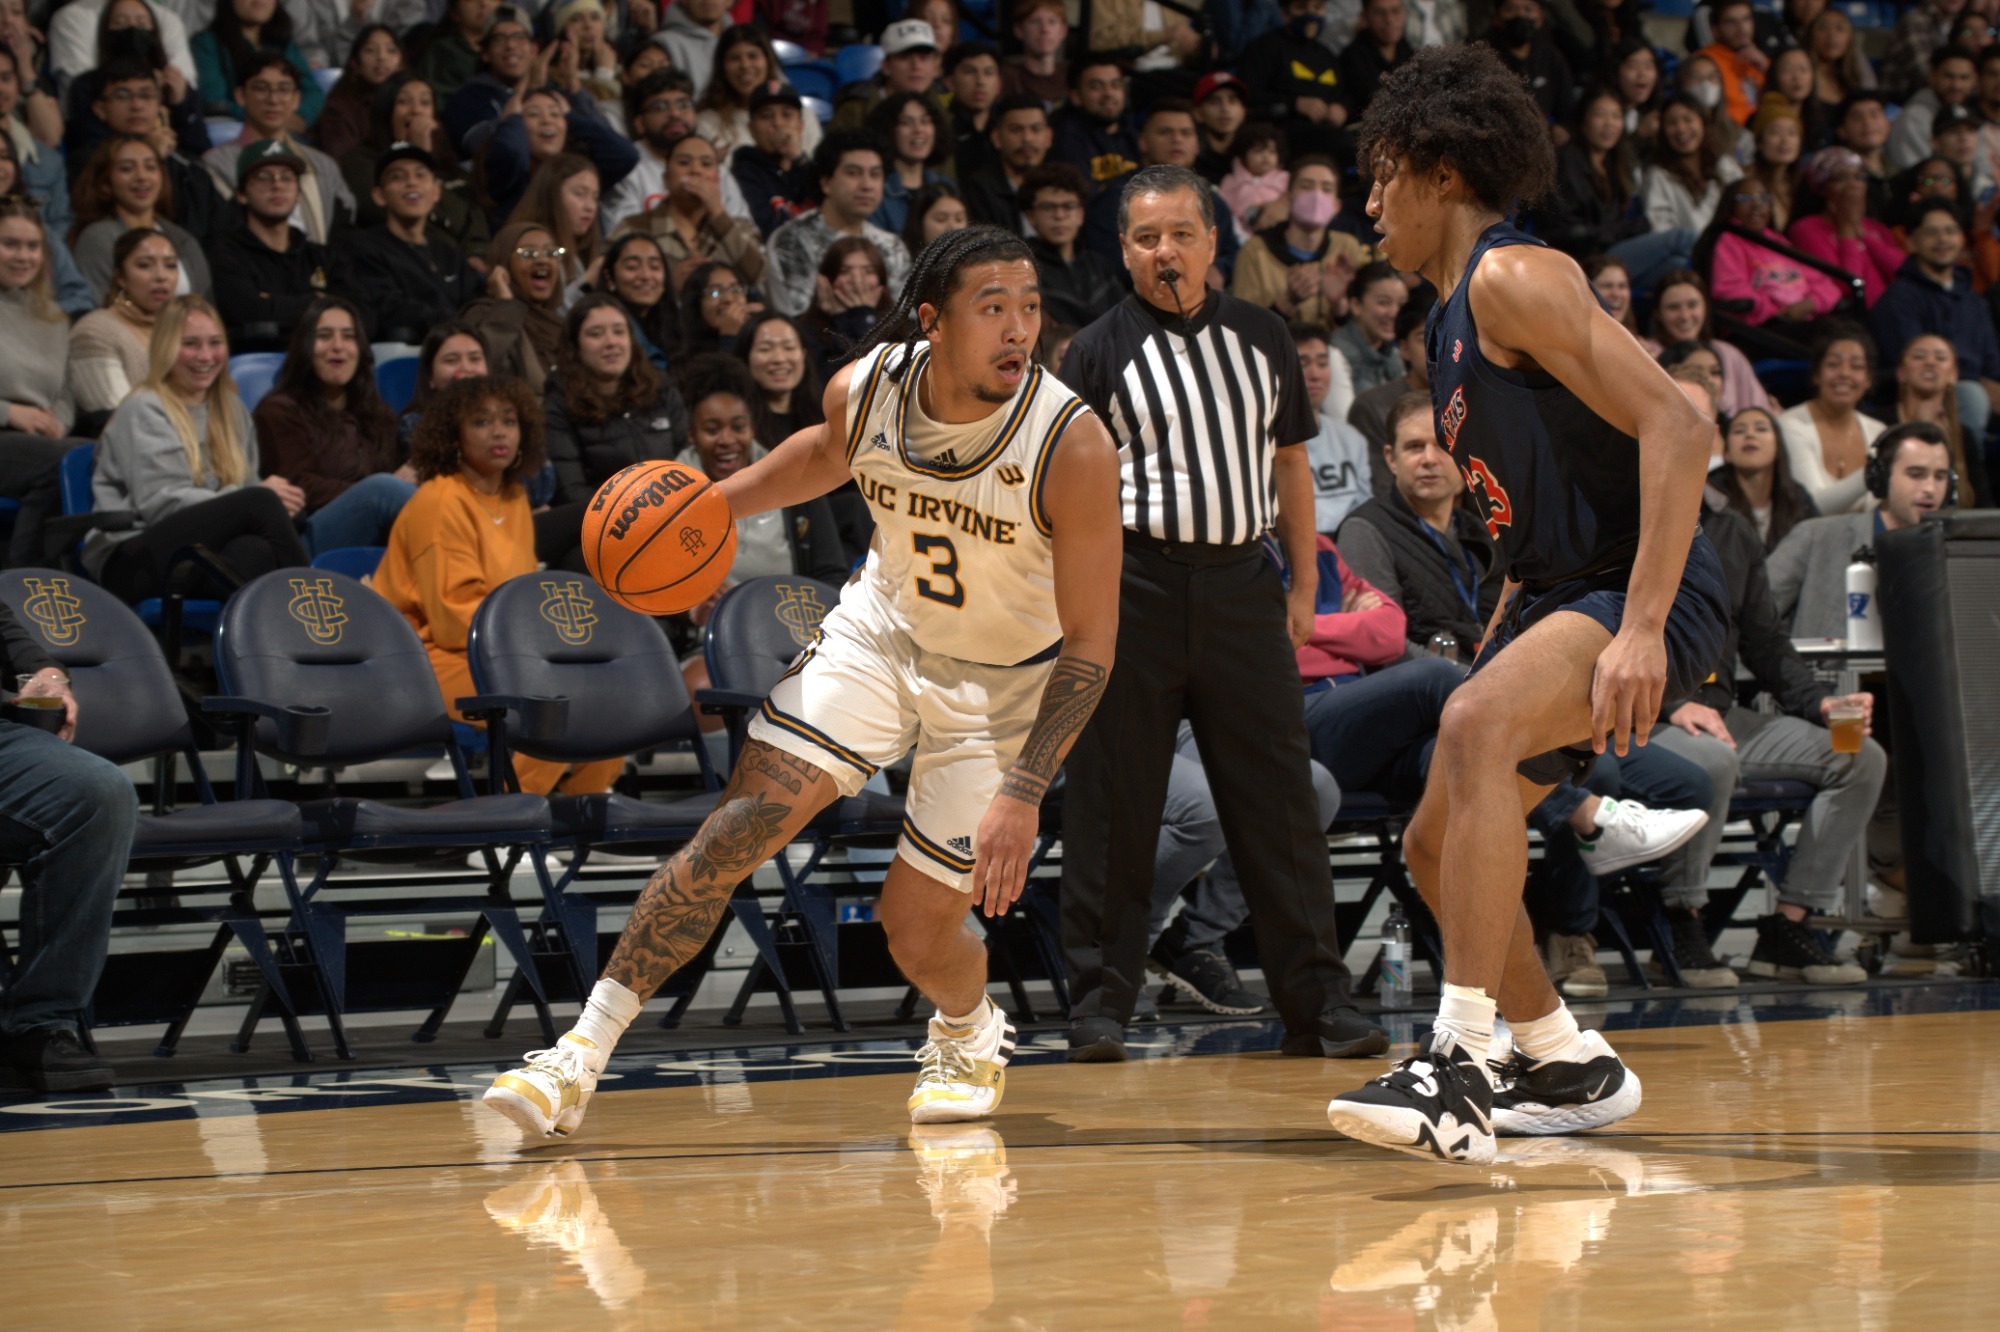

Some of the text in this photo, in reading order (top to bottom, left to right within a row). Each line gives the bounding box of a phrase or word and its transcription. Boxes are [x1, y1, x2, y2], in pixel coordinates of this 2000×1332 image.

[928, 459, 959, 471] adid
[607, 469, 697, 541] Wilson
[859, 471, 1016, 546] UC IRVINE
[911, 530, 968, 611] 3
[946, 839, 974, 857] adidas
